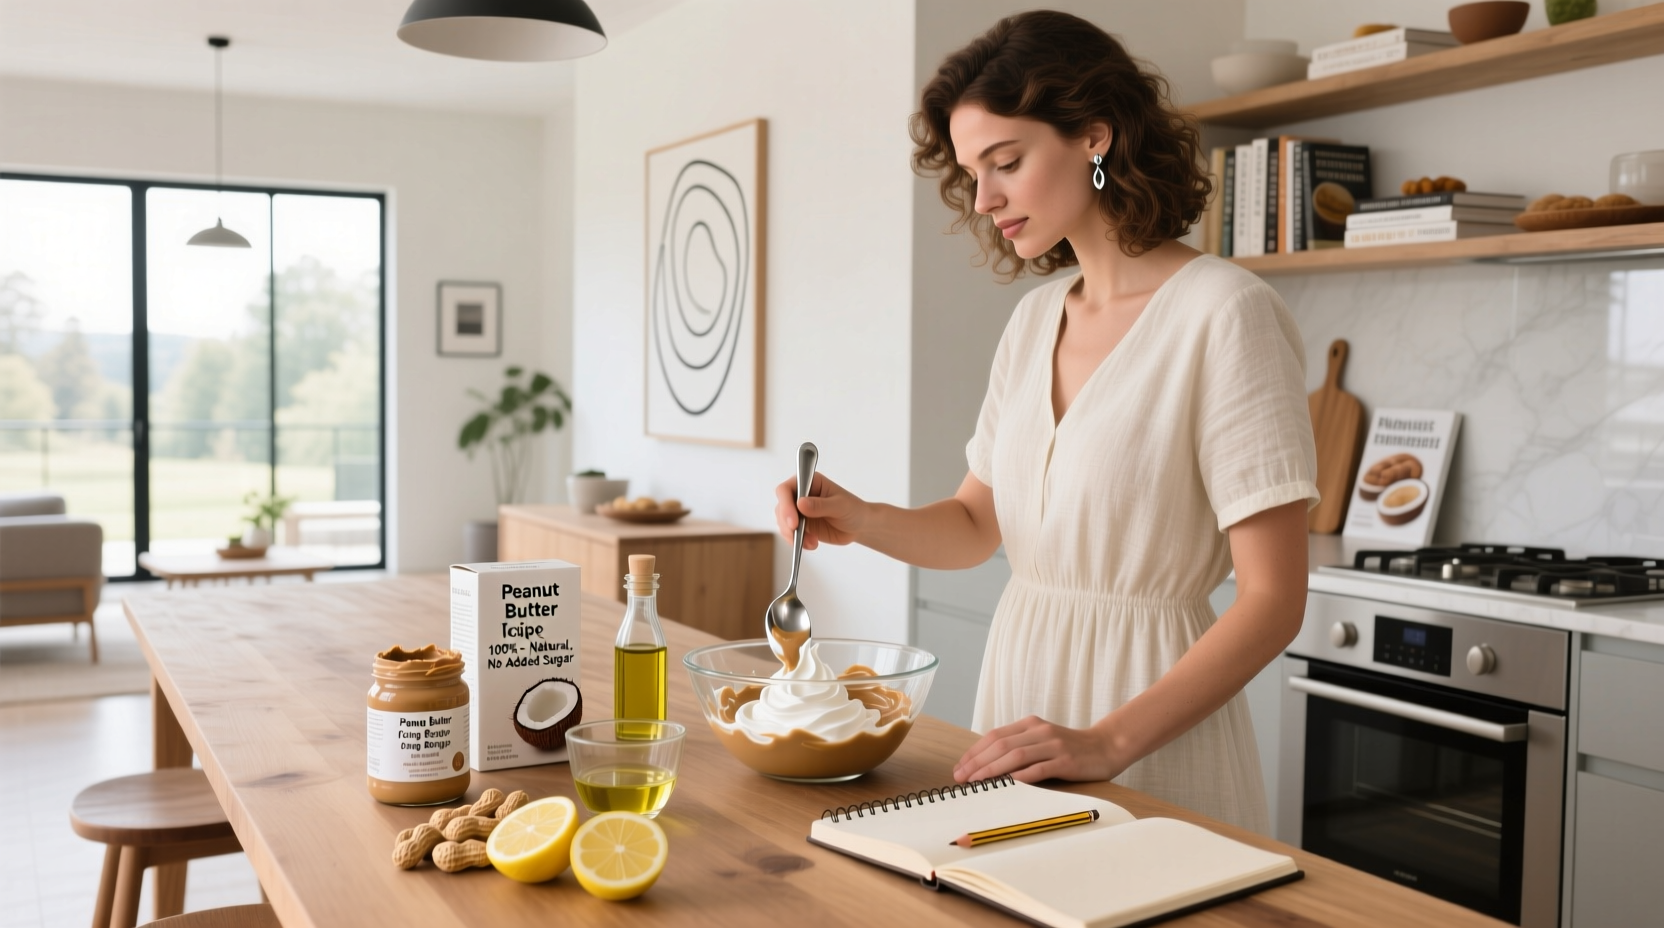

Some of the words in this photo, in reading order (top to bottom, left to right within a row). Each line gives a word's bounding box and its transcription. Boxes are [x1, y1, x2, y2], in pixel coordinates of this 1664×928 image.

[502, 583, 559, 600] Peanut
[505, 603, 558, 619] Butter
[488, 659, 502, 670] No
[505, 656, 540, 669] Added
[543, 654, 574, 667] Sugar
